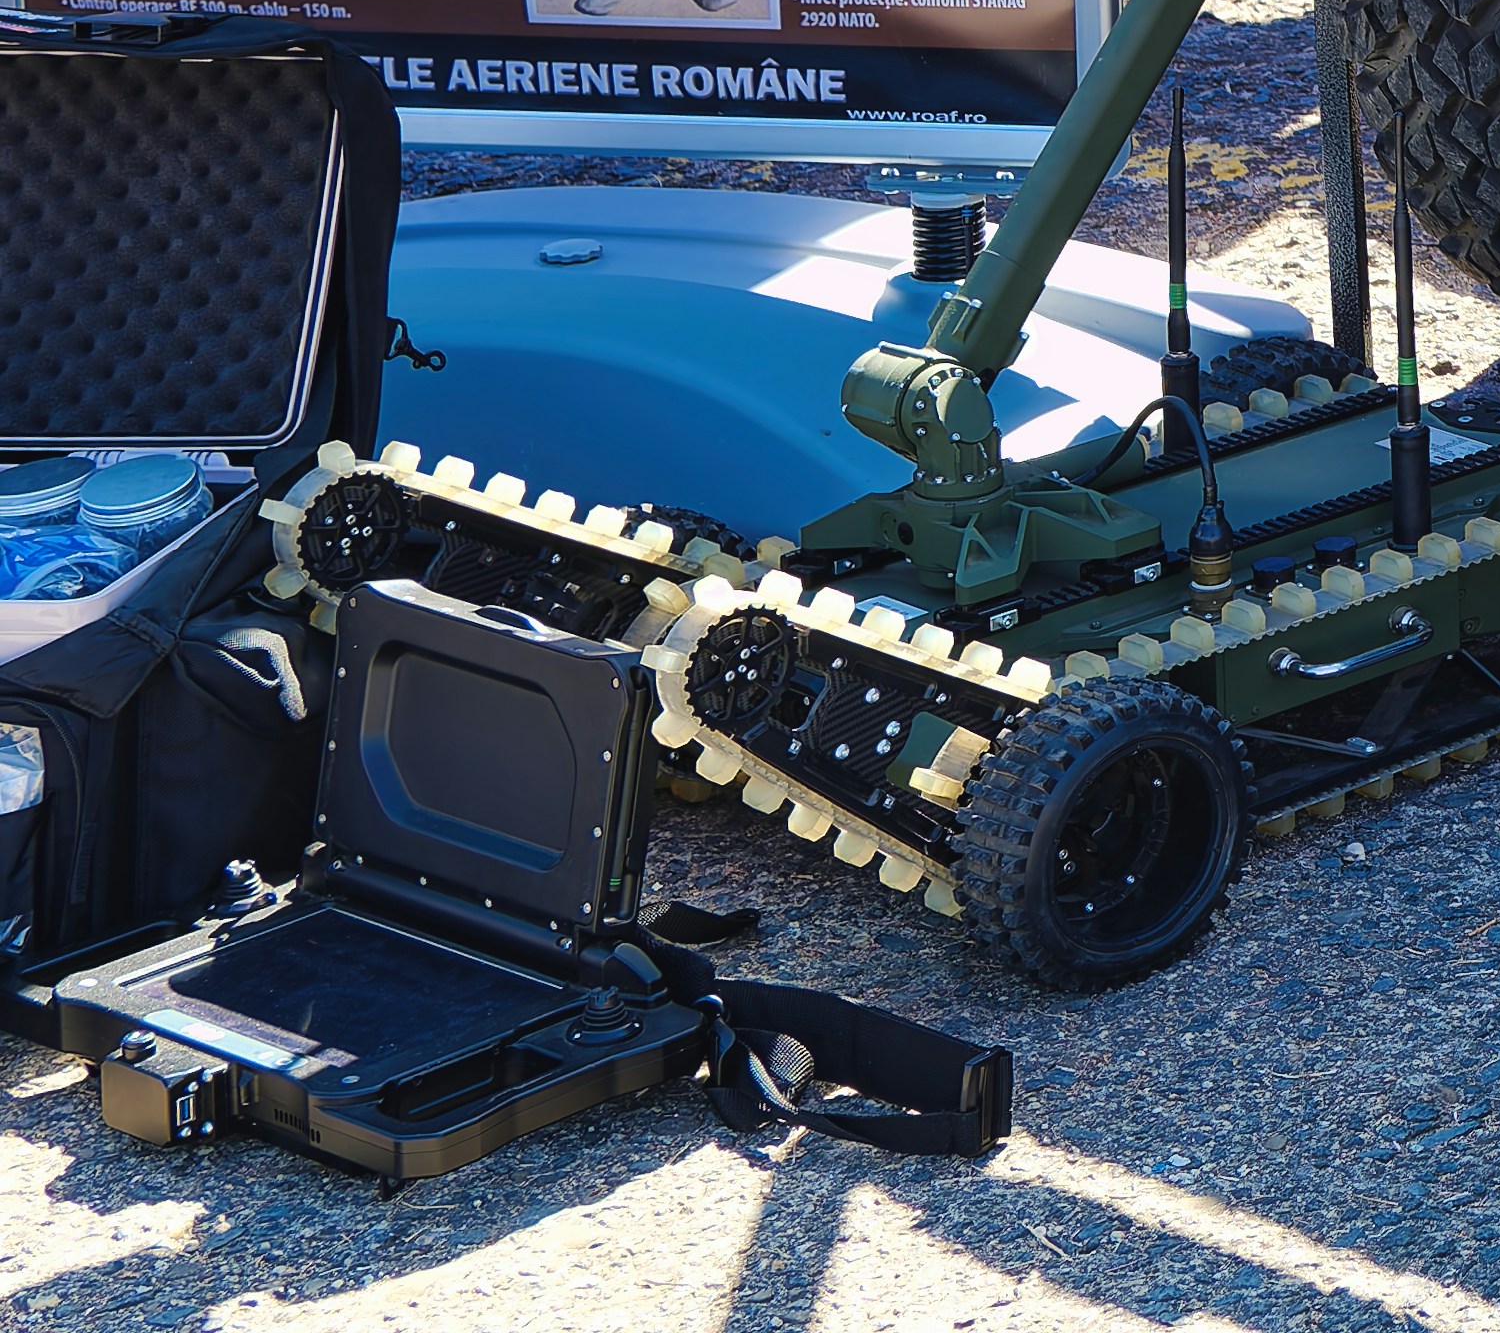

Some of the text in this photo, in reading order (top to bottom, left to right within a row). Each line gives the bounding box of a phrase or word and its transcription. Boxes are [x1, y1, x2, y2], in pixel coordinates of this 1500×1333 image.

[800, 12, 880, 28] 2920 NATO.
[448, 58, 640, 98] AERIENE
[652, 56, 848, 104] ROMÂNE
[846, 107, 988, 124] www.roaf.ro
